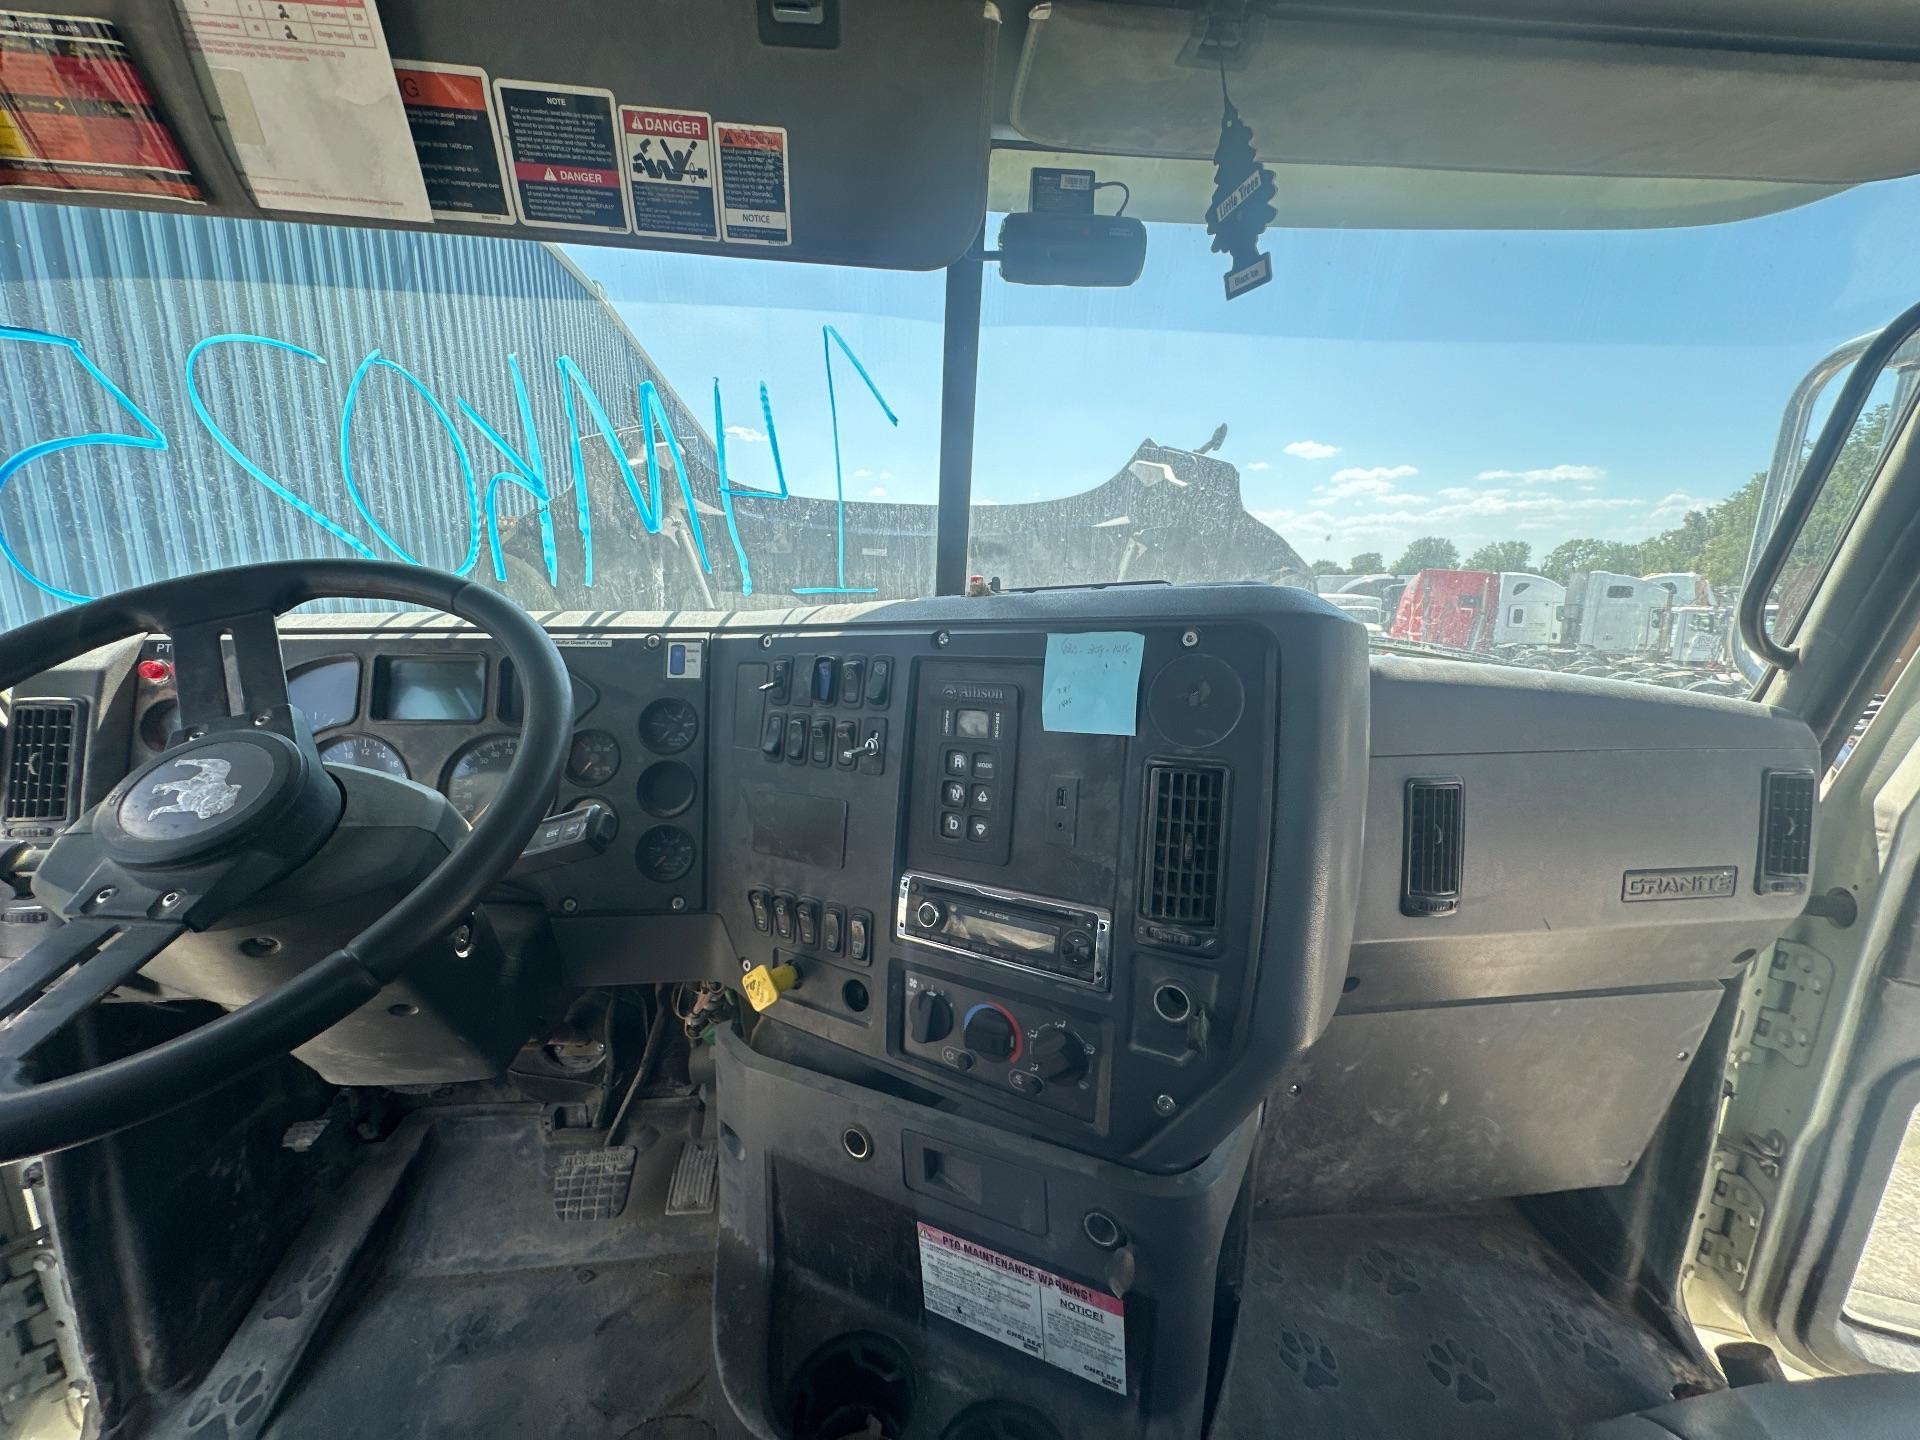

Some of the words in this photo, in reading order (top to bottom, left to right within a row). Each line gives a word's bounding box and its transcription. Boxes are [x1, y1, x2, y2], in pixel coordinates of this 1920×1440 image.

[546, 97, 566, 106] NOTE
[644, 118, 702, 135] DANGER
[560, 170, 602, 183] DANGER
[1218, 195, 1238, 218] Little
[742, 214, 770, 223] NOTICE
[156, 643, 172, 653] PT
[952, 789, 960, 799] N
[950, 820, 958, 830] D
[1628, 875, 1732, 896] GRANITE
[979, 909, 1009, 920] MACK
[942, 1236, 960, 1250] PTO
[964, 1244, 1034, 1280] MAINTENANCE
[1038, 1272, 1092, 1301] WARNING!
[1060, 1298, 1105, 1321] NOTICE!
[1006, 1330, 1042, 1348] CHELSEA
[1084, 1365, 1122, 1384] CHELSEA
